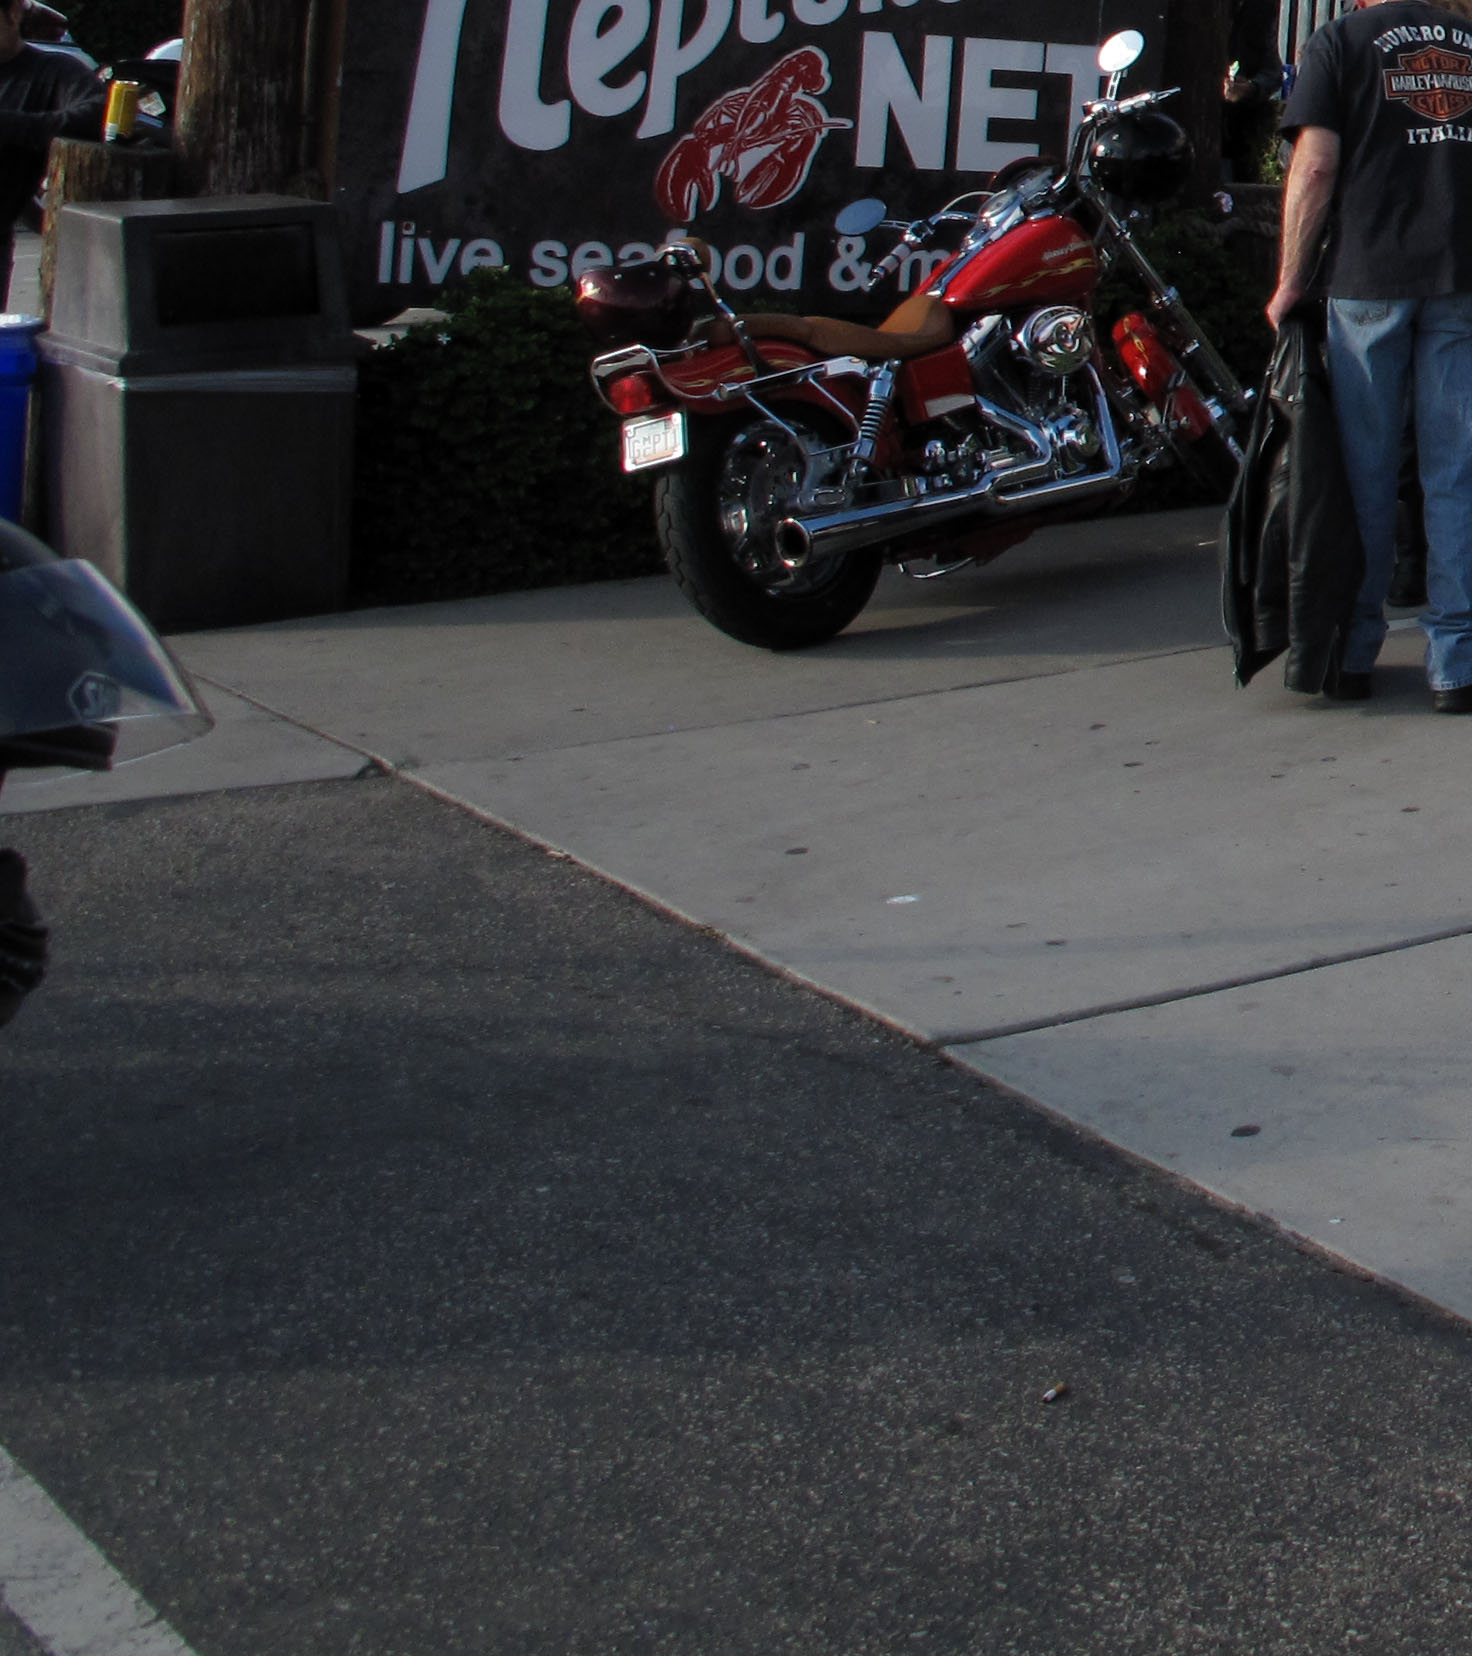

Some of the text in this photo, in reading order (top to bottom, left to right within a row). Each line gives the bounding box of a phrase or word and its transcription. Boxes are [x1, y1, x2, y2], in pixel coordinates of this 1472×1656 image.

[1374, 24, 1446, 53] NUMERO
[854, 31, 1112, 174] NET
[378, 221, 505, 285] live
[529, 228, 805, 291] seaod
[828, 235, 874, 292] &
